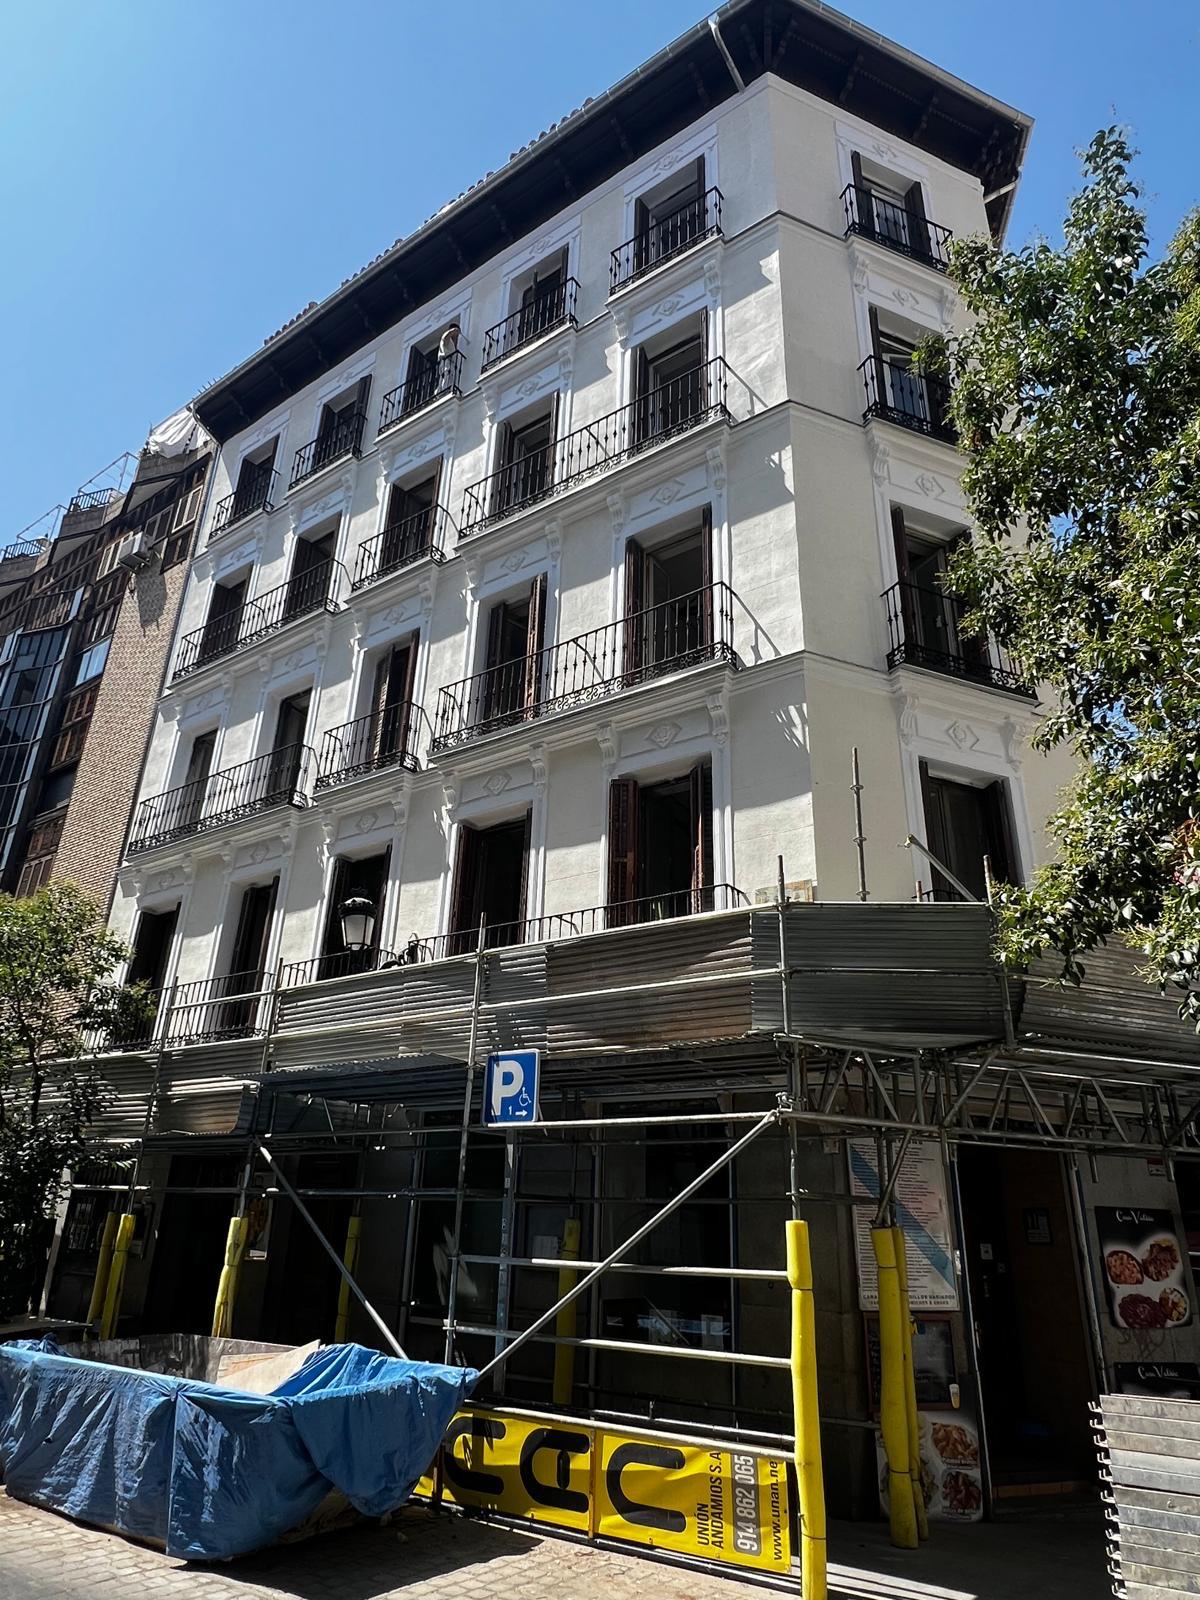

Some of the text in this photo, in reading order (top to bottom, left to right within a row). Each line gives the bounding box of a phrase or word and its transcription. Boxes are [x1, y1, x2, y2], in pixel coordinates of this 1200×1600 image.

[491, 1060, 524, 1116] P
[508, 1105, 513, 1116] 1
[694, 1502, 710, 1546] UNIÓN
[709, 1476, 724, 1550] ANDAMIOS
[733, 1454, 758, 1551] 914 862 065
[769, 1461, 783, 1561] www.unan.ne
